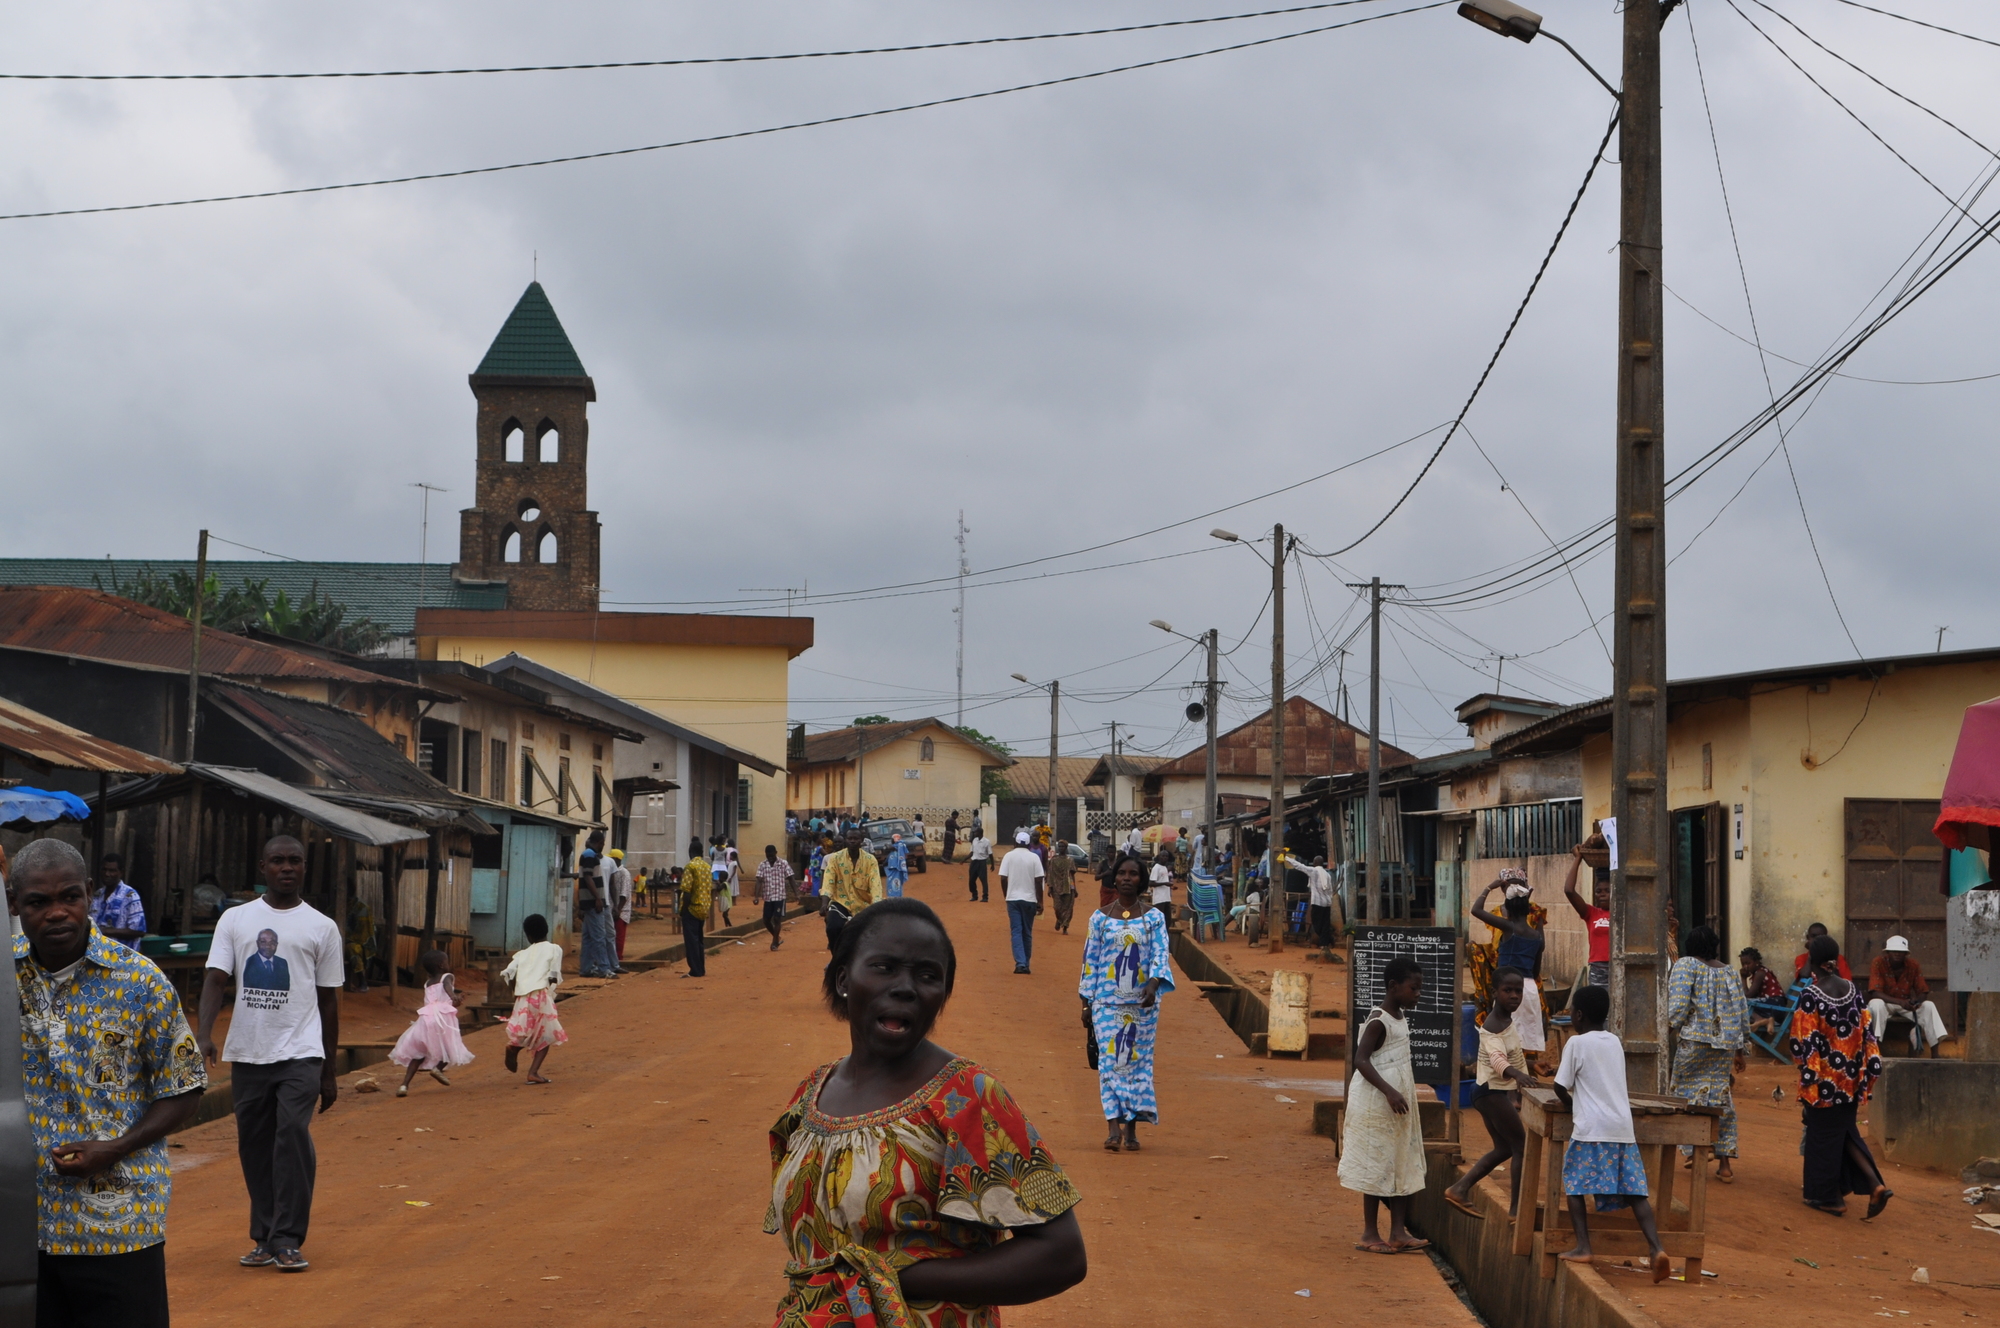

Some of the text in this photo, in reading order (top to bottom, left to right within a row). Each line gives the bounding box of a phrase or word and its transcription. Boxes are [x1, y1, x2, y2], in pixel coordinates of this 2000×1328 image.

[1386, 933, 1405, 941] TOP
[243, 988, 288, 998] PARRAIN
[241, 995, 289, 1004] Jean-Paul
[246, 1002, 280, 1010] MONIN
